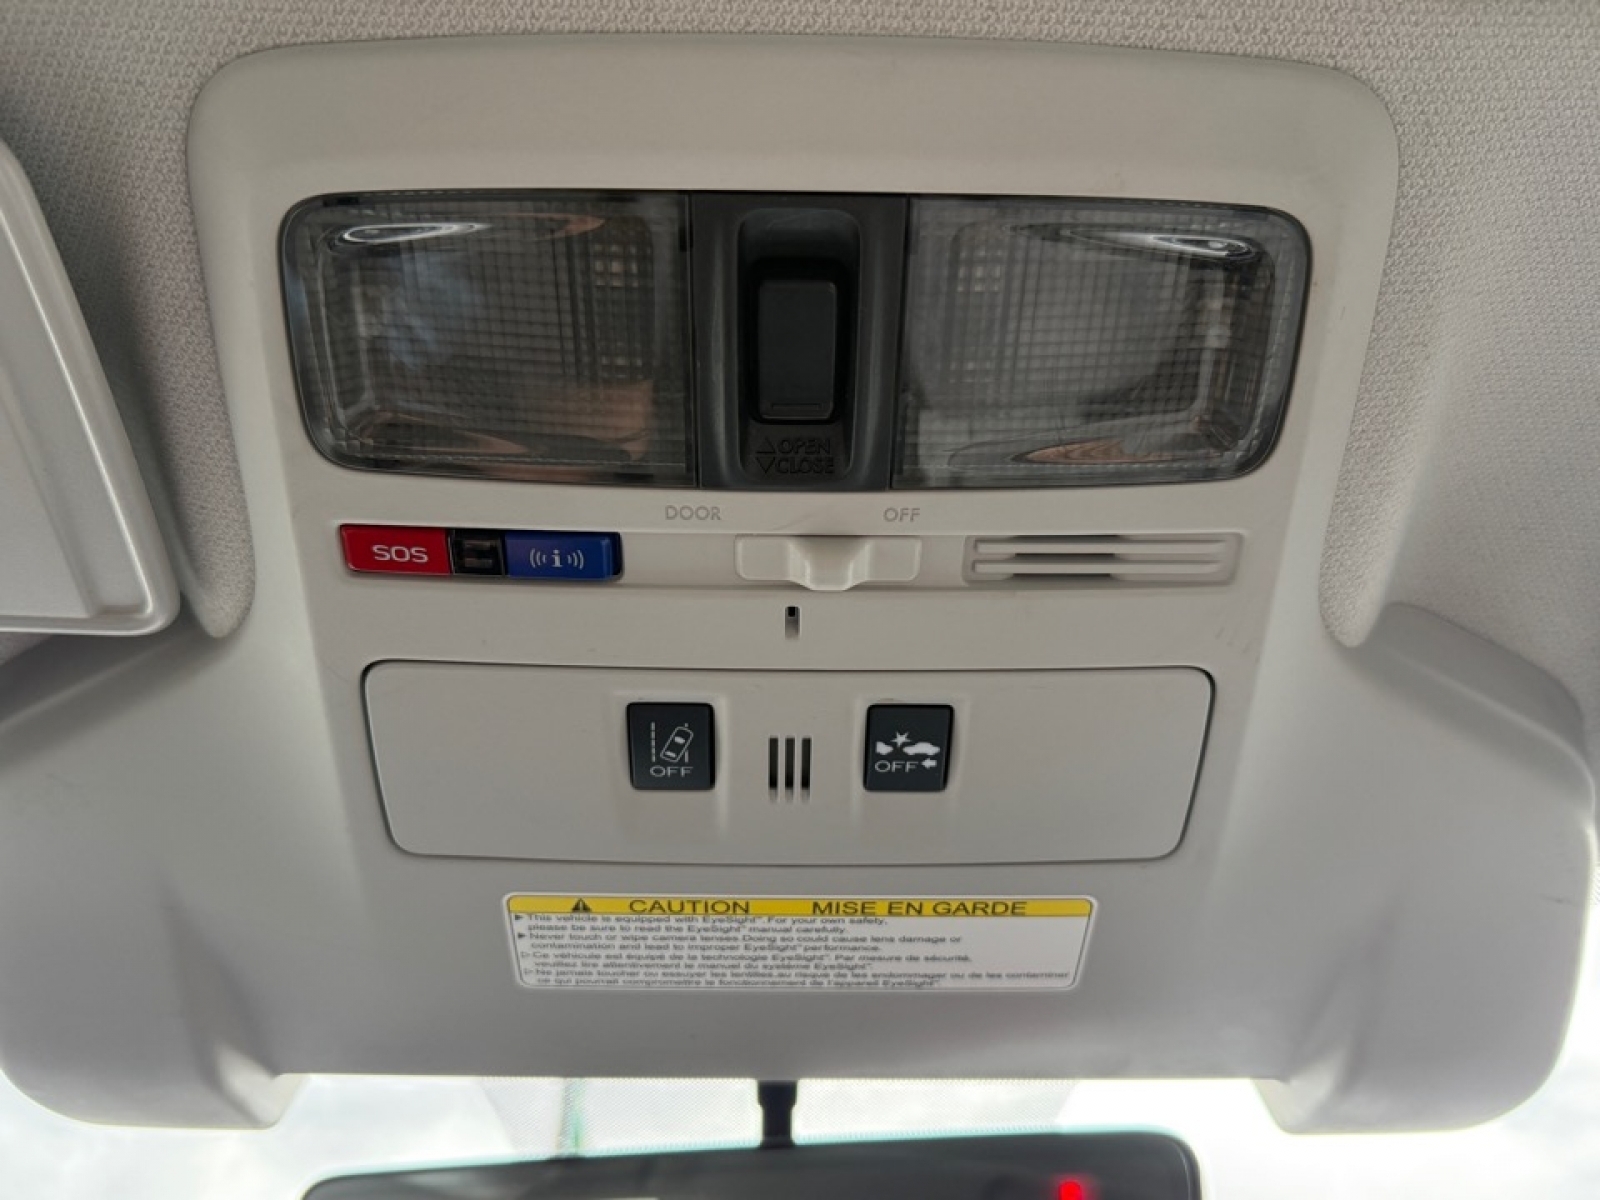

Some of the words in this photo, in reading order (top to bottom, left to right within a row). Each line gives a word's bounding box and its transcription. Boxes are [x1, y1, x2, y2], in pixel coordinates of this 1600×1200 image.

[779, 438, 831, 454] OPEN
[775, 457, 834, 474] CLOSE
[665, 505, 722, 521] DOOR
[883, 507, 920, 523] OFF
[372, 544, 429, 564] SOS
[650, 765, 694, 778] OFF
[874, 760, 919, 773] OFF
[629, 900, 749, 914] CAUTION
[812, 901, 876, 915] MISE
[887, 901, 923, 915] EN
[932, 901, 1028, 915] GARDE
[616, 915, 670, 923] equipped
[850, 917, 887, 926] safety,
[622, 934, 648, 942] wipe
[898, 936, 946, 944] damage
